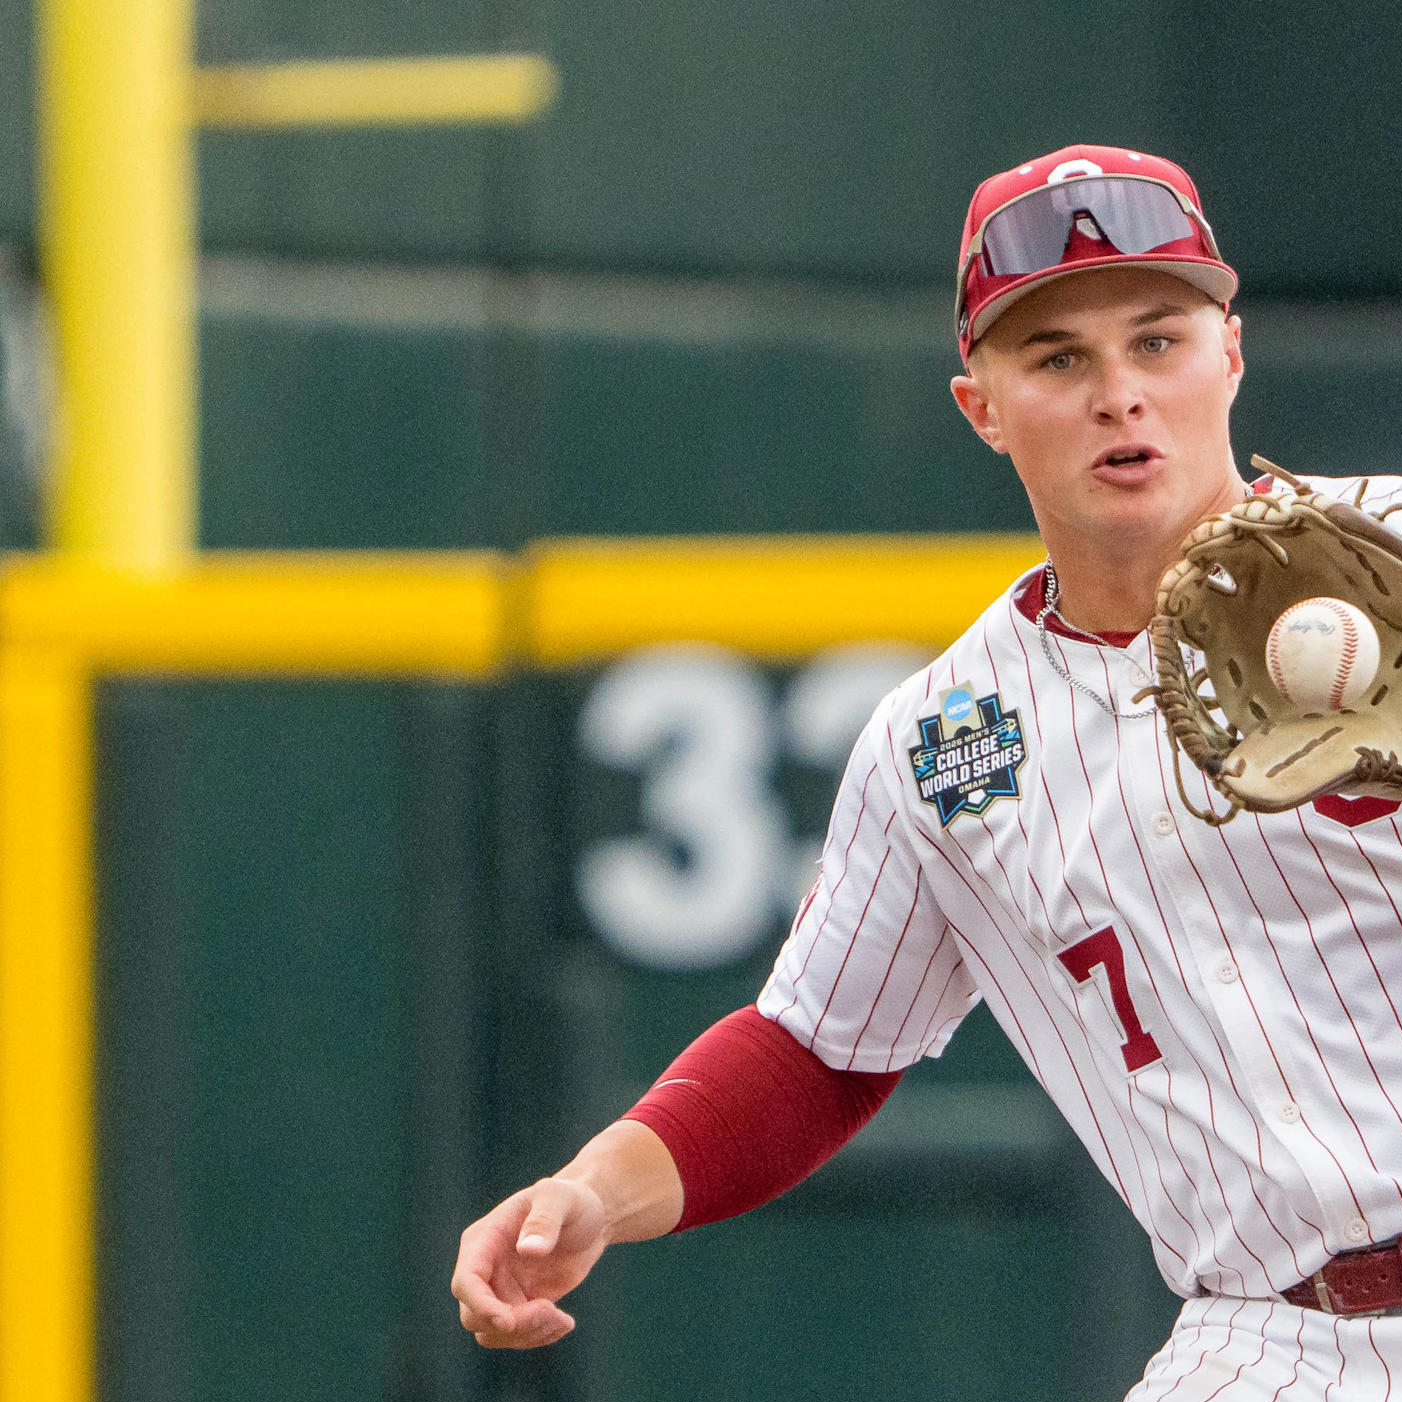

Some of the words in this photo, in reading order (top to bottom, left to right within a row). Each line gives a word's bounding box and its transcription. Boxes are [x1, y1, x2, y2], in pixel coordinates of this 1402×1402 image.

[947, 699, 973, 717] NCAA
[920, 763, 971, 798] WORLD
[972, 743, 1022, 778] SERIES
[936, 734, 999, 772] COLLEGE
[958, 776, 991, 794] OMAHA
[1056, 925, 1163, 1073] 7
